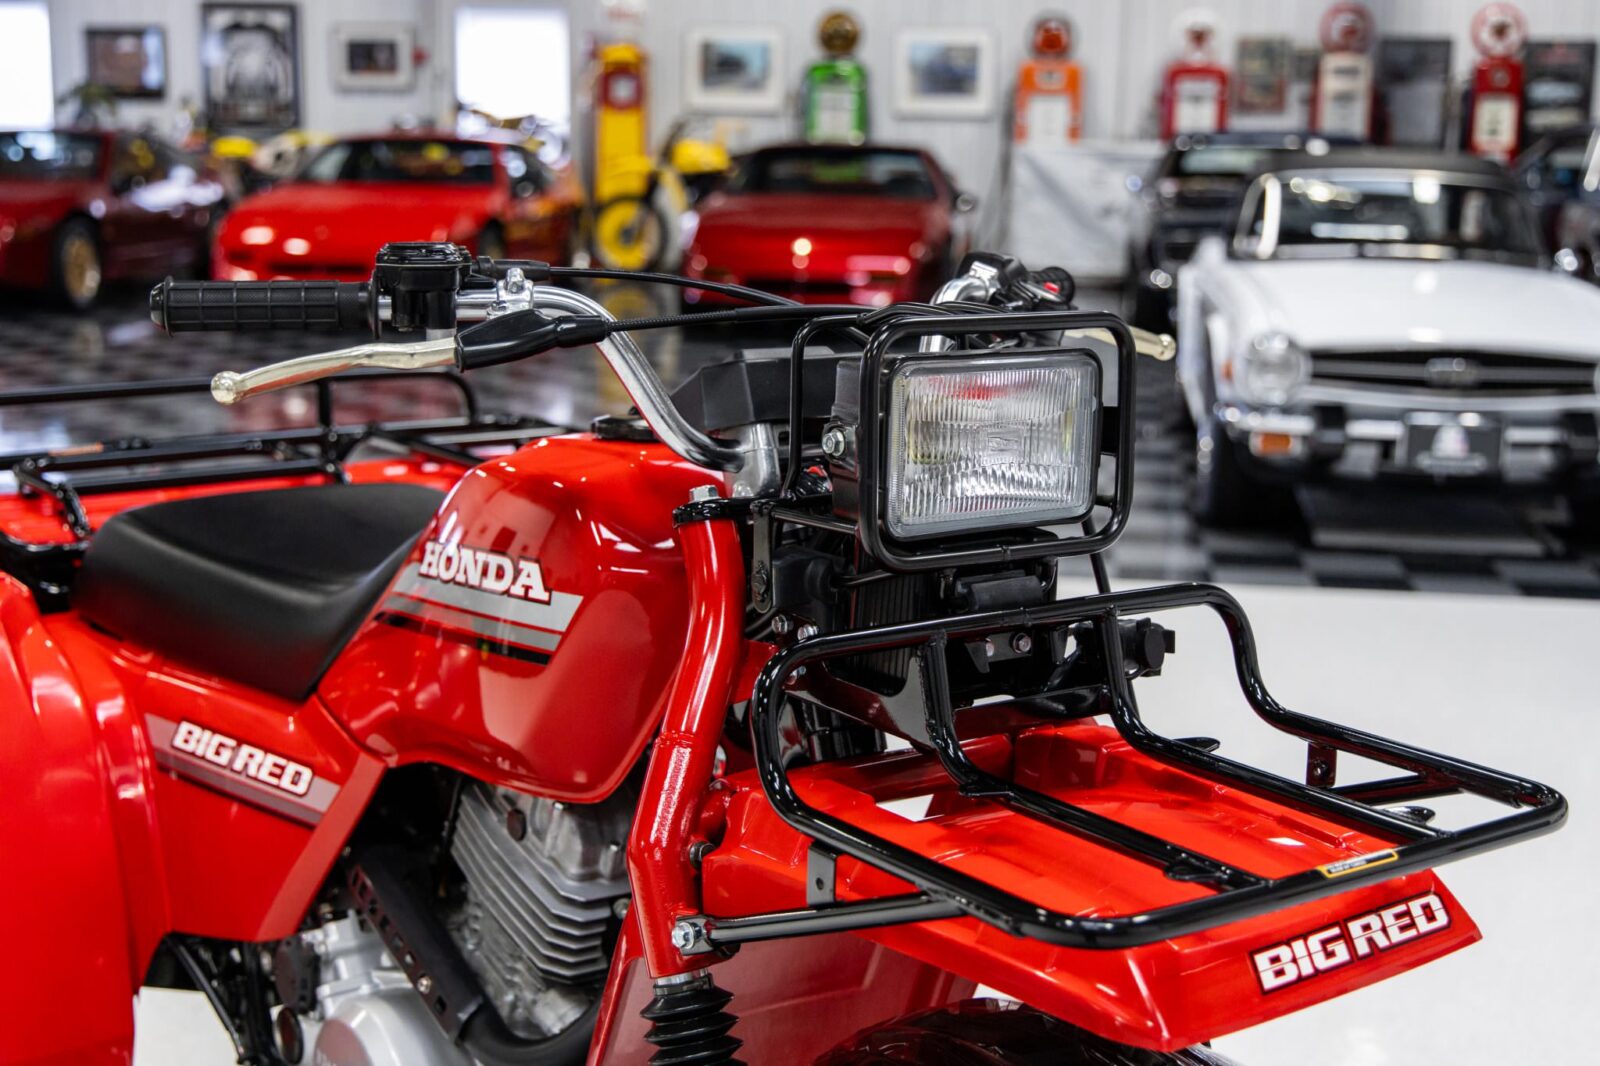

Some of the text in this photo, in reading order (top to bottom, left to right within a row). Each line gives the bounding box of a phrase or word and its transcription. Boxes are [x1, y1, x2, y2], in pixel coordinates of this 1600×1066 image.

[419, 541, 551, 603] HONDA
[172, 720, 313, 796] BIG RED
[1253, 894, 1450, 992] BIG RED
